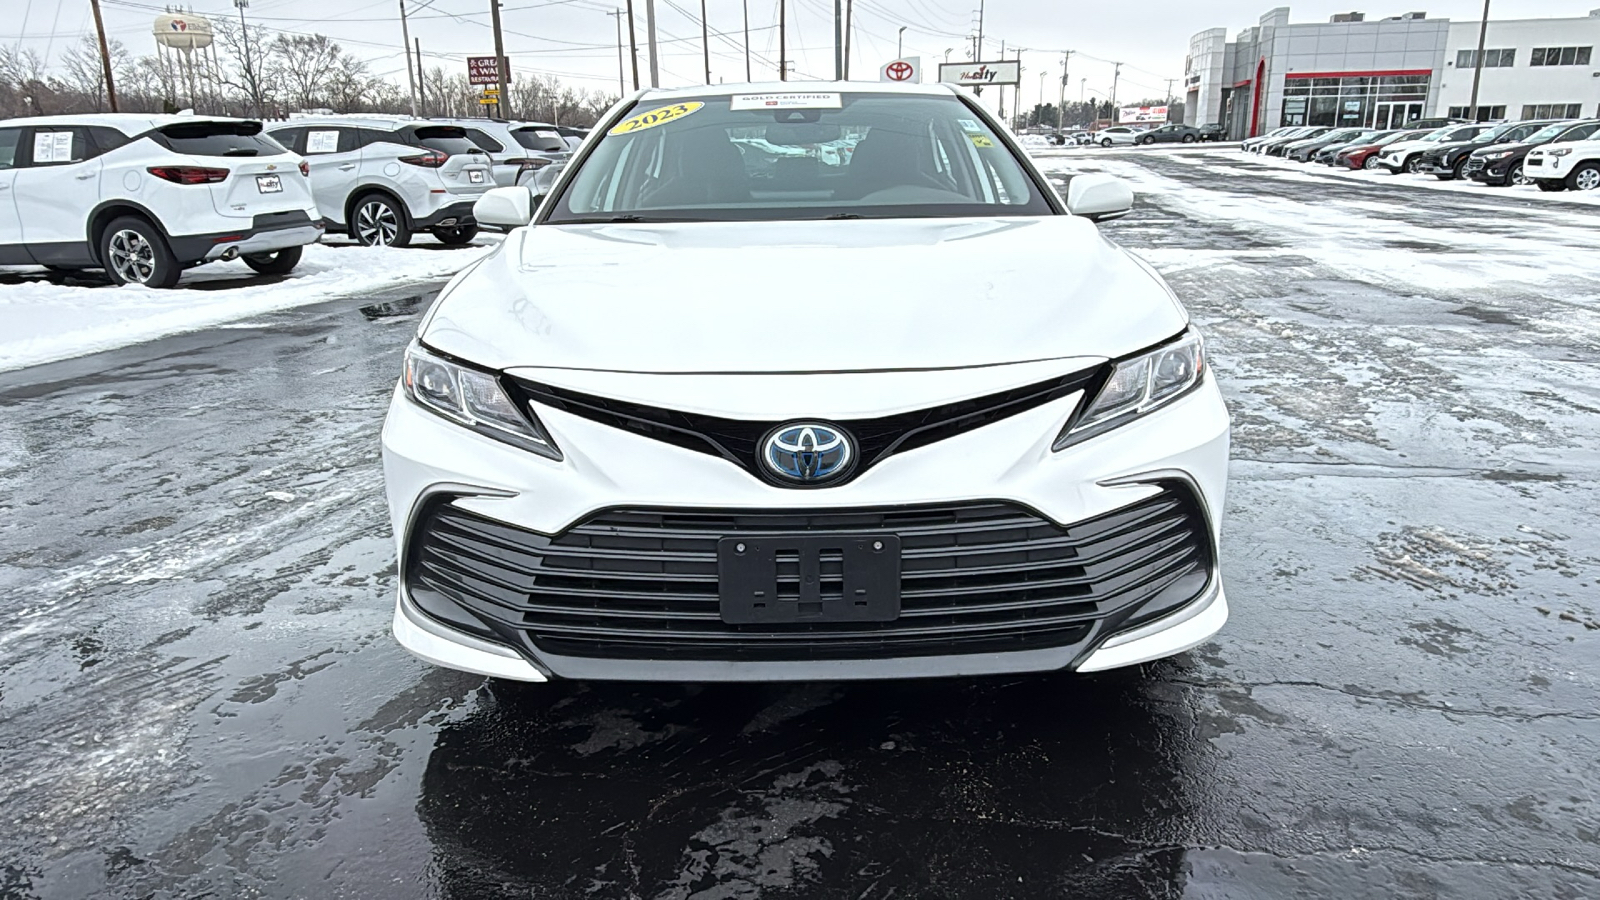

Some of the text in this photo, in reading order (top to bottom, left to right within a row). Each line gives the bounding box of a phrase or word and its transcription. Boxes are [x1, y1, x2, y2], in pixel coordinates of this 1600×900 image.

[478, 59, 497, 67] GRE
[479, 67, 498, 75] WAL
[625, 104, 688, 131] 2023
